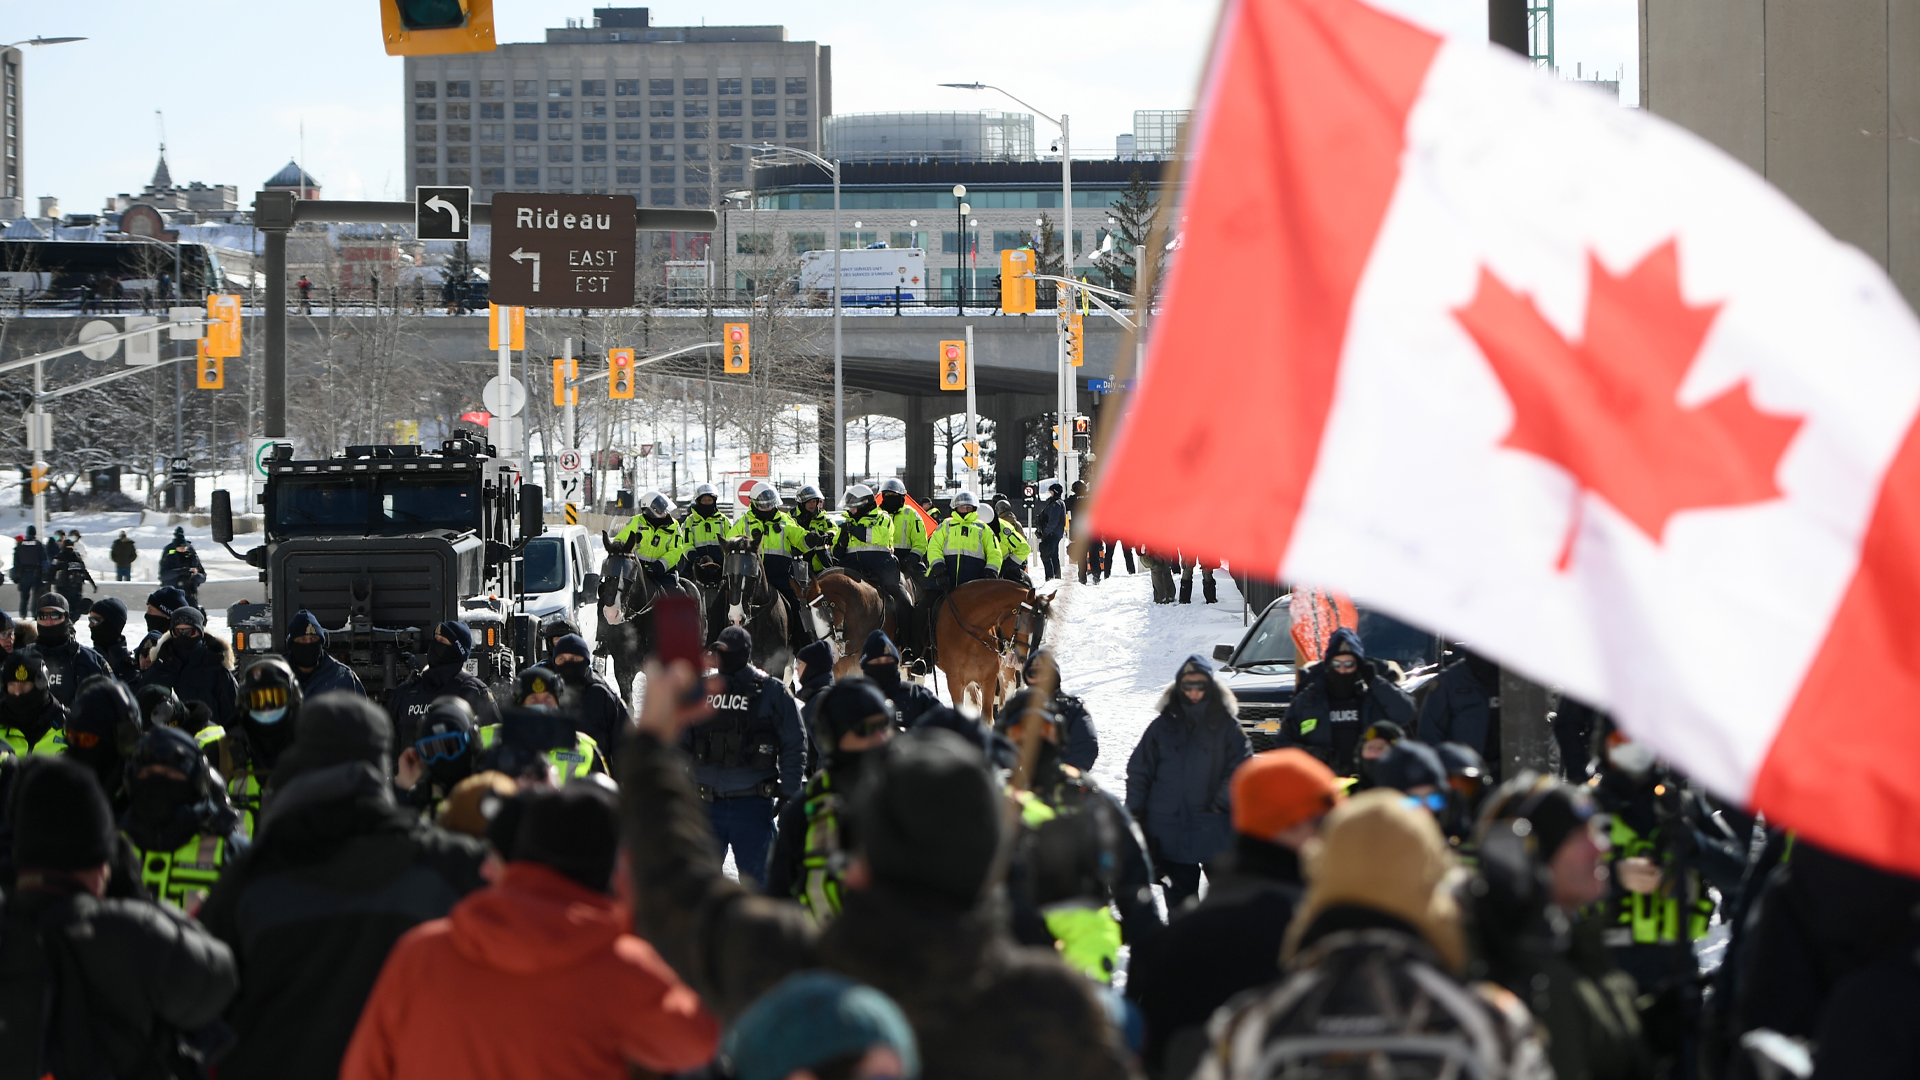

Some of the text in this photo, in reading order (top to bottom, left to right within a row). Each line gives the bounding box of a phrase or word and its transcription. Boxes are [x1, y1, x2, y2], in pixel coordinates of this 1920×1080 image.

[516, 207, 610, 230] Rideau
[569, 250, 617, 266] EAST
[576, 276, 610, 292] EST
[1103, 380, 1116, 390] Daly
[172, 459, 187, 470] 40
[408, 703, 432, 716] POLIC
[706, 694, 748, 711] POLICE
[1329, 710, 1358, 722] OLICE
